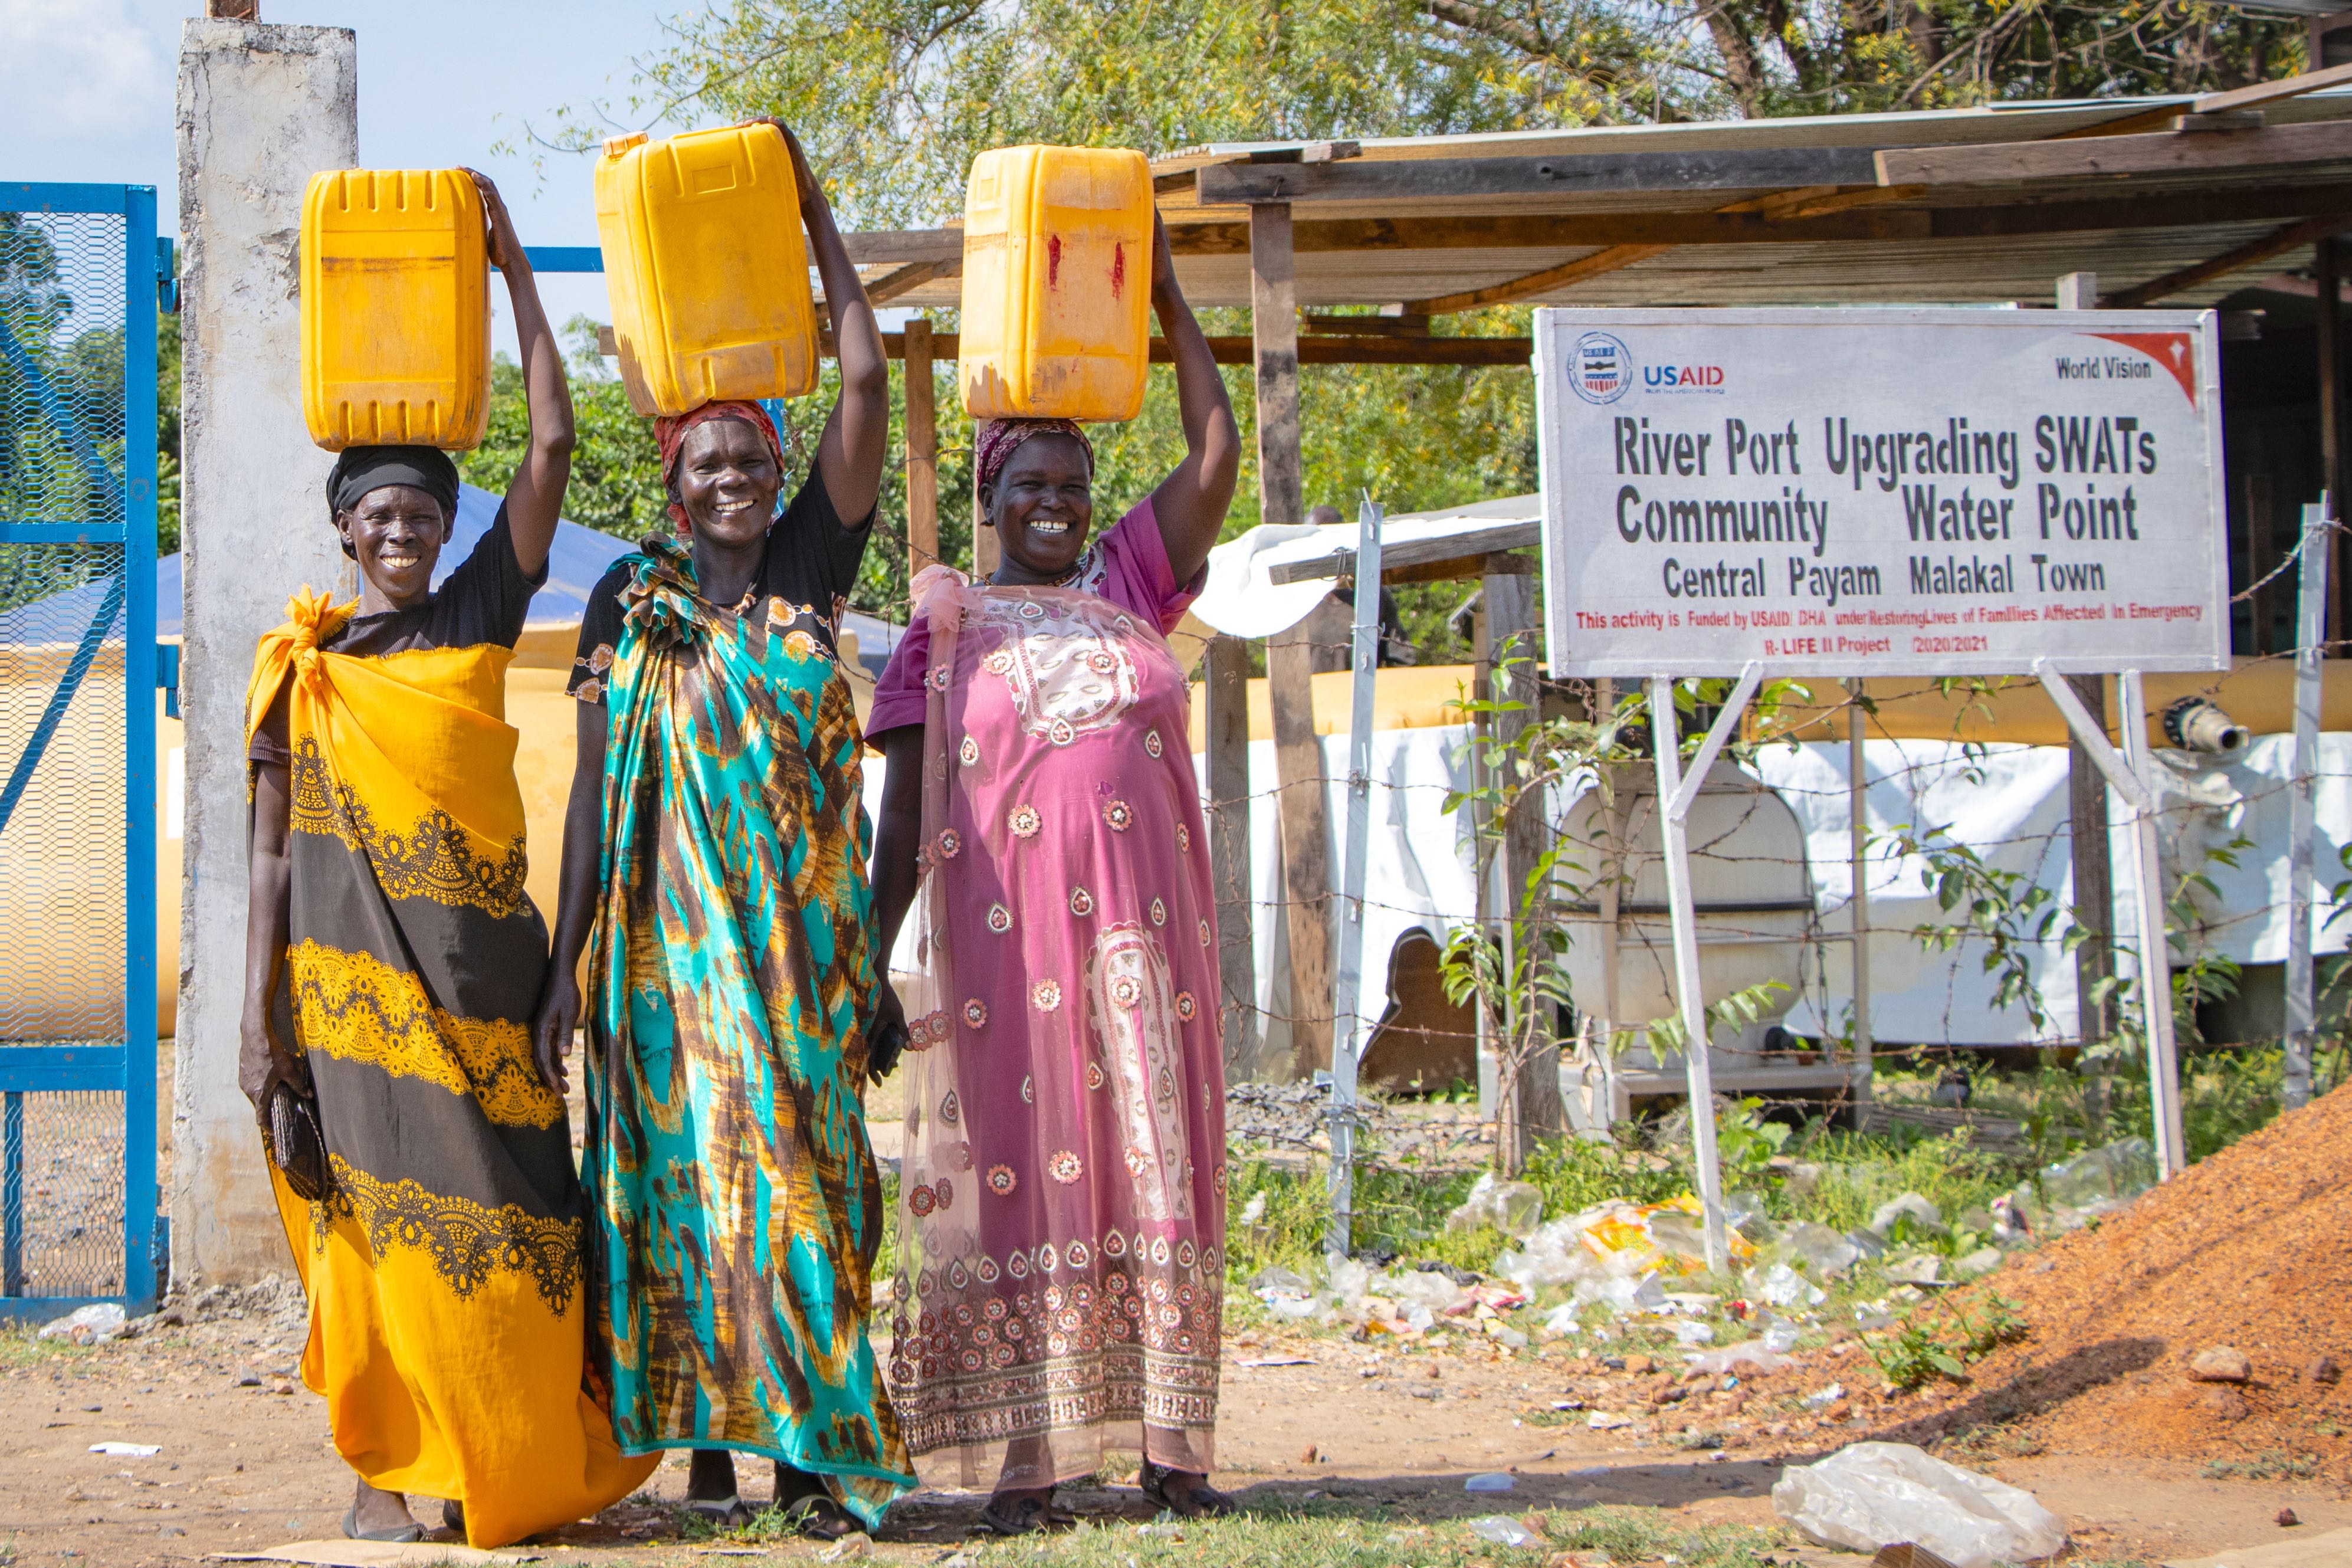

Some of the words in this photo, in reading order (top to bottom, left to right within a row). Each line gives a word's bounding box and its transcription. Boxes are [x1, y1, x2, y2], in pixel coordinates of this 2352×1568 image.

[1645, 366, 1724, 386] USAID
[2056, 357, 2100, 379] World
[2104, 357, 2152, 379] Vision
[1615, 416, 1711, 476] River
[1726, 418, 1800, 475] Port
[1825, 416, 2019, 492] Upgrading
[2036, 415, 2156, 474] SWATs
[1617, 484, 1828, 557] Community
[1902, 484, 2015, 541] Water
[2038, 483, 2138, 540] Point
[1664, 558, 1765, 598] Central
[1789, 556, 1881, 607] Payam
[1910, 555, 2013, 594] Malakal
[2031, 554, 2105, 592] Town
[1576, 612, 1606, 629] This
[1612, 611, 1663, 631] activity
[1669, 611, 1680, 626] is
[1688, 611, 1730, 626] Funded
[1734, 611, 1747, 630] by
[1836, 611, 1866, 625] under
[1963, 608, 1974, 623] of
[2044, 605, 2105, 620] Affected
[2129, 603, 2202, 622] Emergency
[1838, 637, 1890, 656] Project
